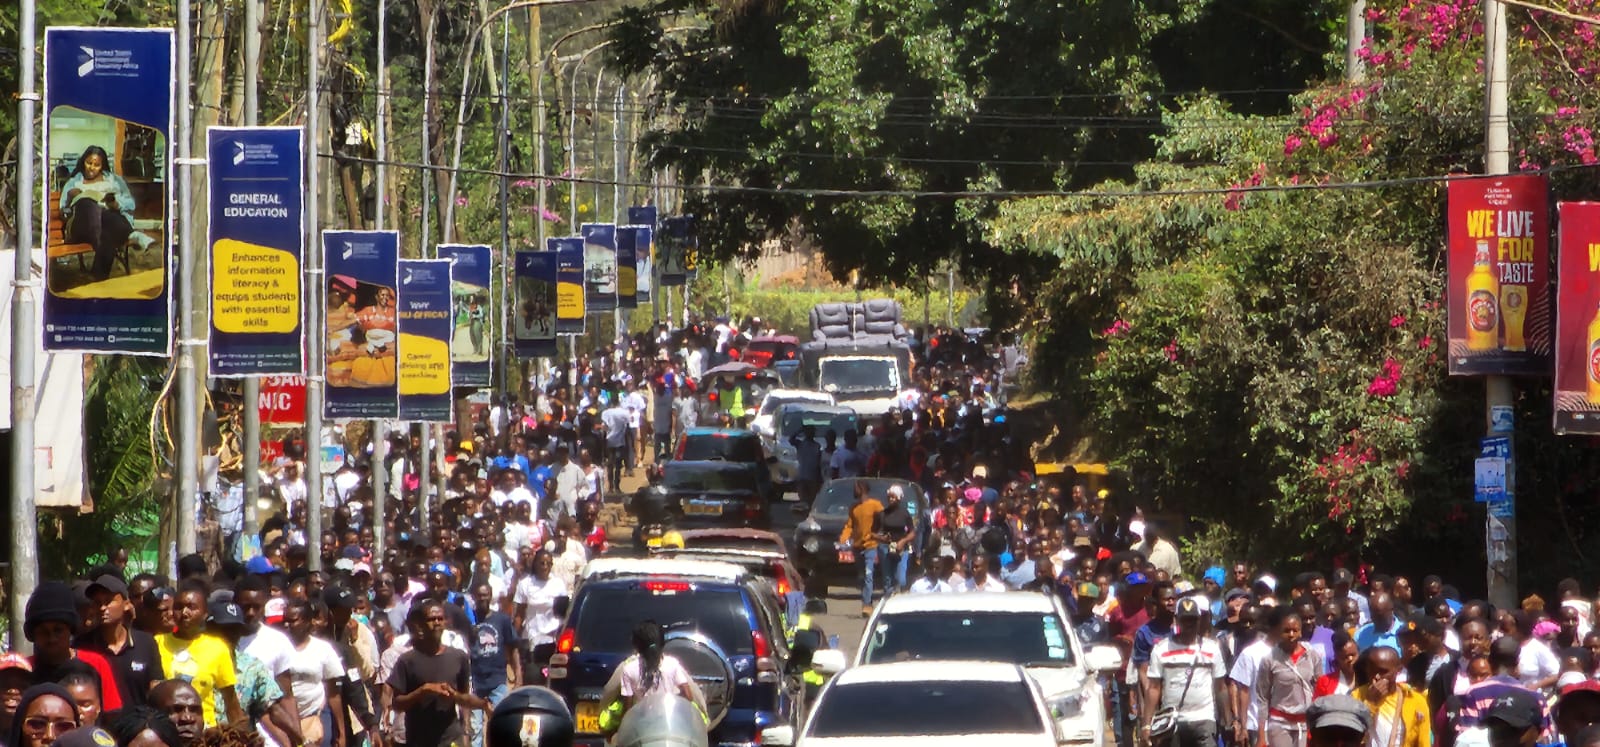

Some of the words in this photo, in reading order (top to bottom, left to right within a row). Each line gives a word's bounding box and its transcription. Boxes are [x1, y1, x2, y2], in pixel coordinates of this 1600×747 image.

[230, 194, 282, 204] GENERAL
[224, 208, 288, 217] EDUCATION
[1467, 210, 1495, 238] WE
[1498, 210, 1534, 237] LIVE
[1498, 237, 1534, 261] FOR
[232, 253, 280, 262] Enhances
[228, 266, 285, 275] information
[1497, 262, 1534, 283] TASTE
[233, 280, 269, 290] literacy
[272, 280, 279, 288] &
[216, 294, 249, 303] equips
[252, 292, 296, 301] students
[222, 306, 242, 314] with
[245, 305, 290, 314] essential
[243, 318, 269, 327] skills
